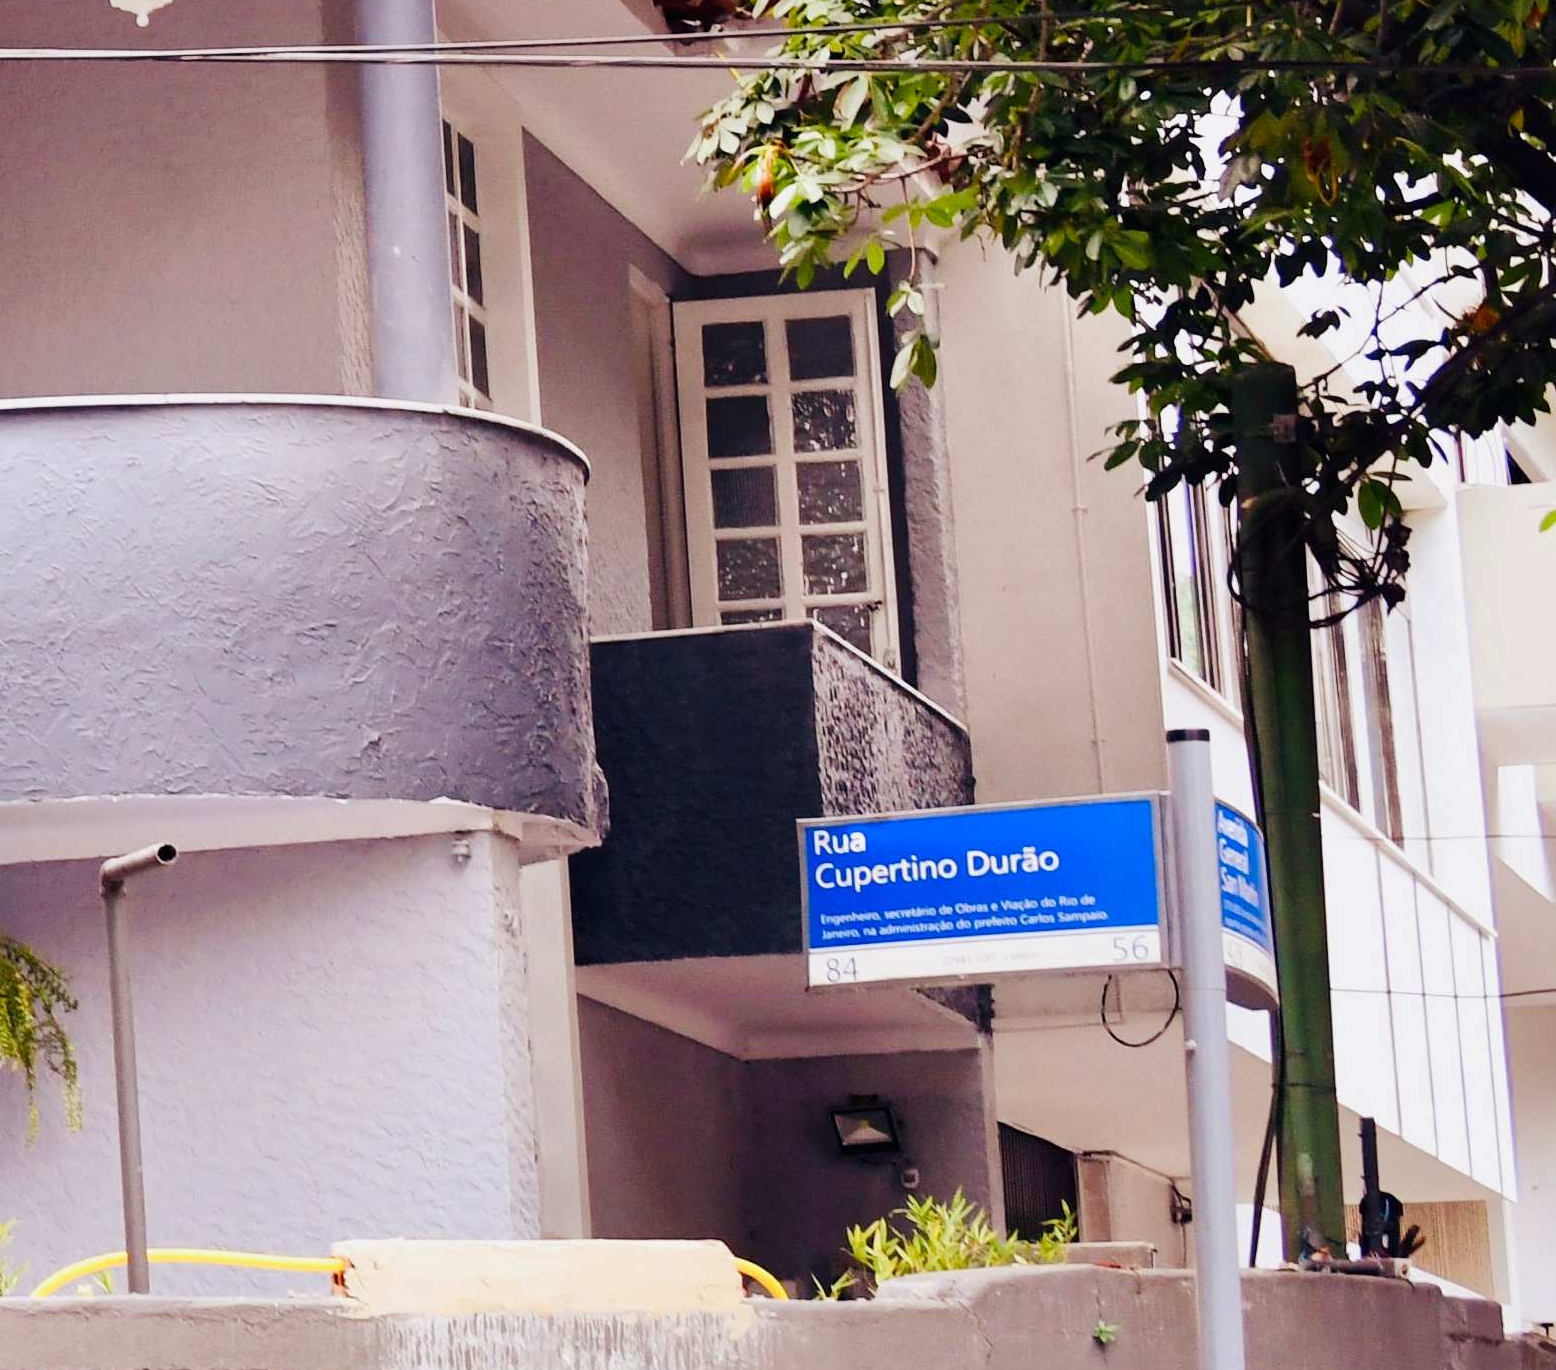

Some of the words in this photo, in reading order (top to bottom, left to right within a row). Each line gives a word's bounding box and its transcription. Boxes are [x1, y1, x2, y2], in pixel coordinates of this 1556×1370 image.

[813, 830, 866, 855] Rua
[815, 855, 958, 893] Cupertino
[966, 846, 1060, 877] Durão
[938, 904, 953, 916] de
[955, 902, 988, 914] Obras
[990, 902, 999, 912] e
[1001, 898, 1038, 911] Viação
[1040, 896, 1056, 908] do
[1058, 895, 1078, 907] Rio
[1080, 893, 1096, 905] de
[863, 926, 877, 937] na
[879, 920, 954, 936] administração
[955, 918, 971, 930] do
[974, 916, 1018, 930] prefeito
[1020, 913, 1055, 925] Carlos
[1112, 934, 1150, 963] 56
[826, 956, 858, 982] 84
